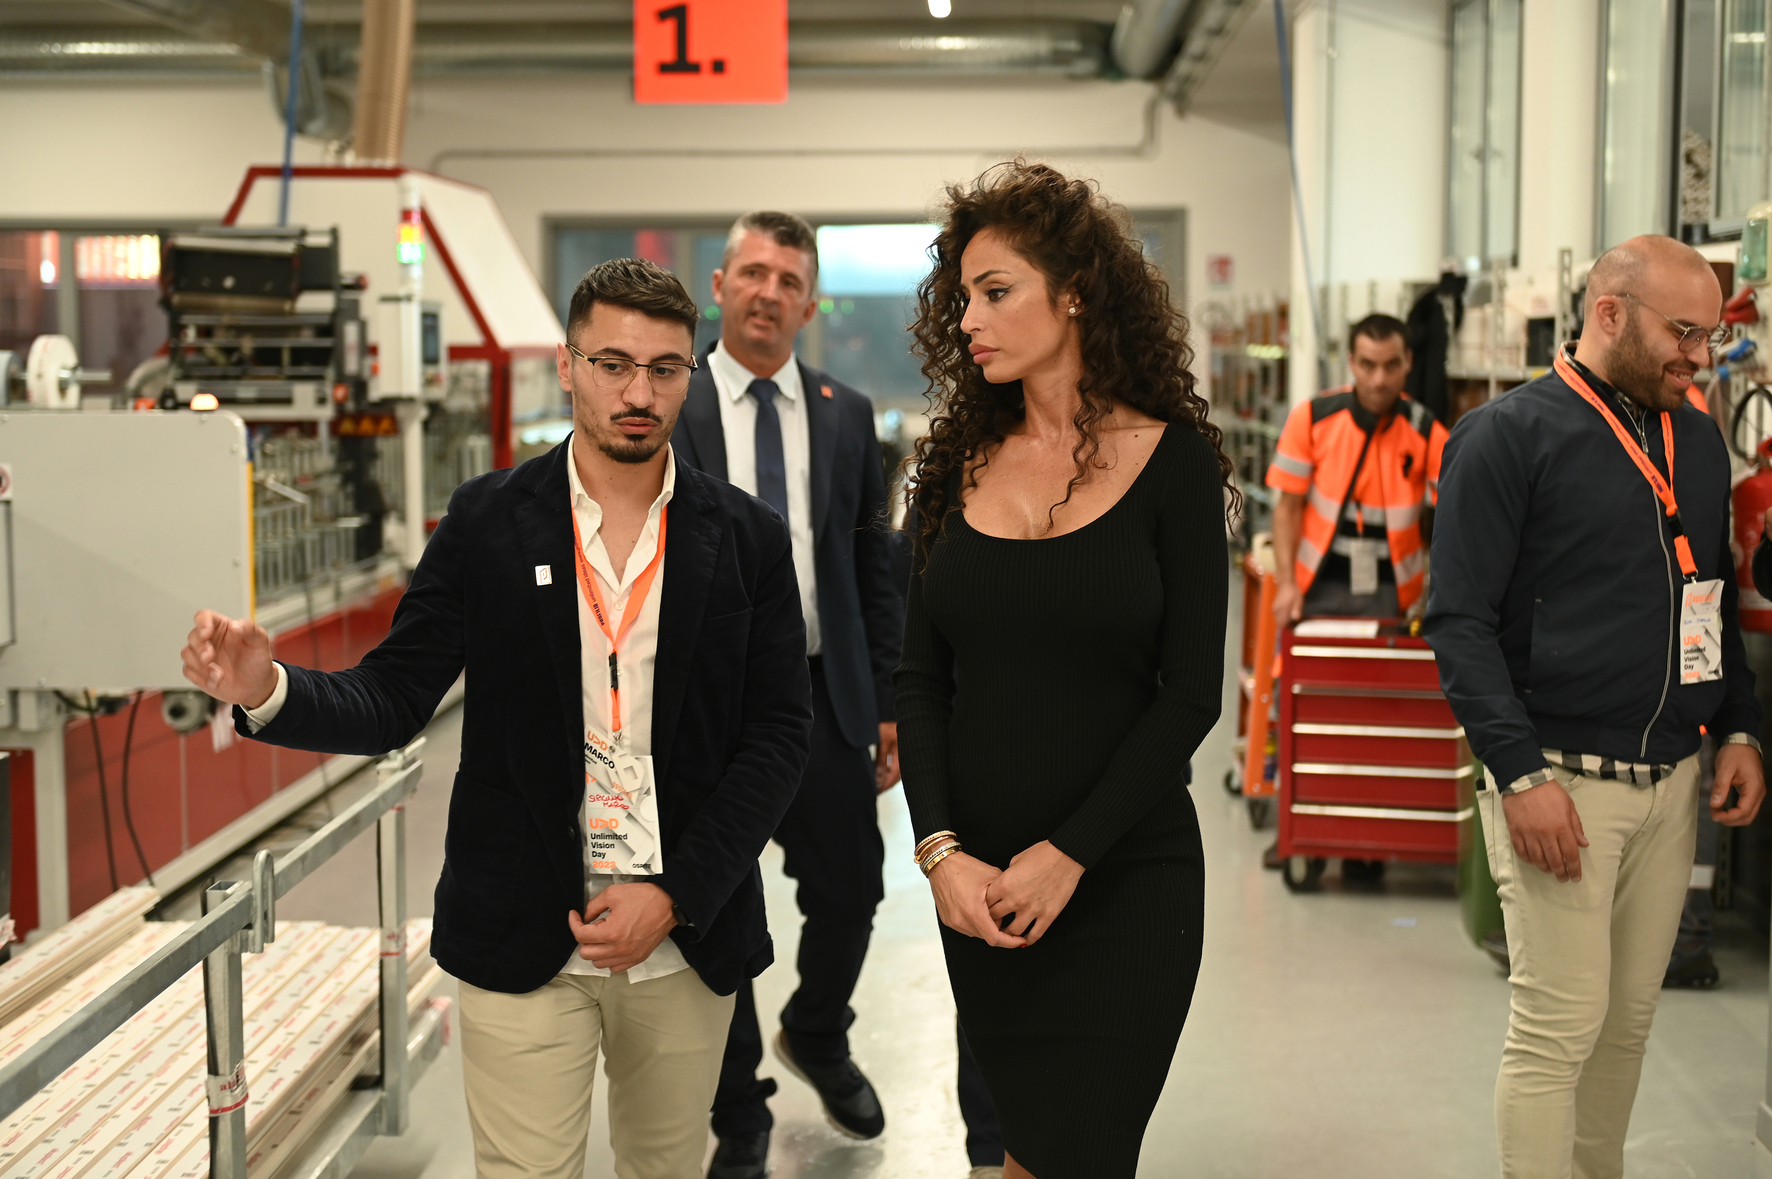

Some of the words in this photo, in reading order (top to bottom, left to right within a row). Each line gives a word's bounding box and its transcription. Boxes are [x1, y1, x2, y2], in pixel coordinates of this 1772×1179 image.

[656, 4, 724, 74] 1.
[581, 563, 589, 578] ideas
[1683, 655, 1699, 663] Vision
[584, 742, 615, 769] MARCO
[591, 851, 606, 859] Day
